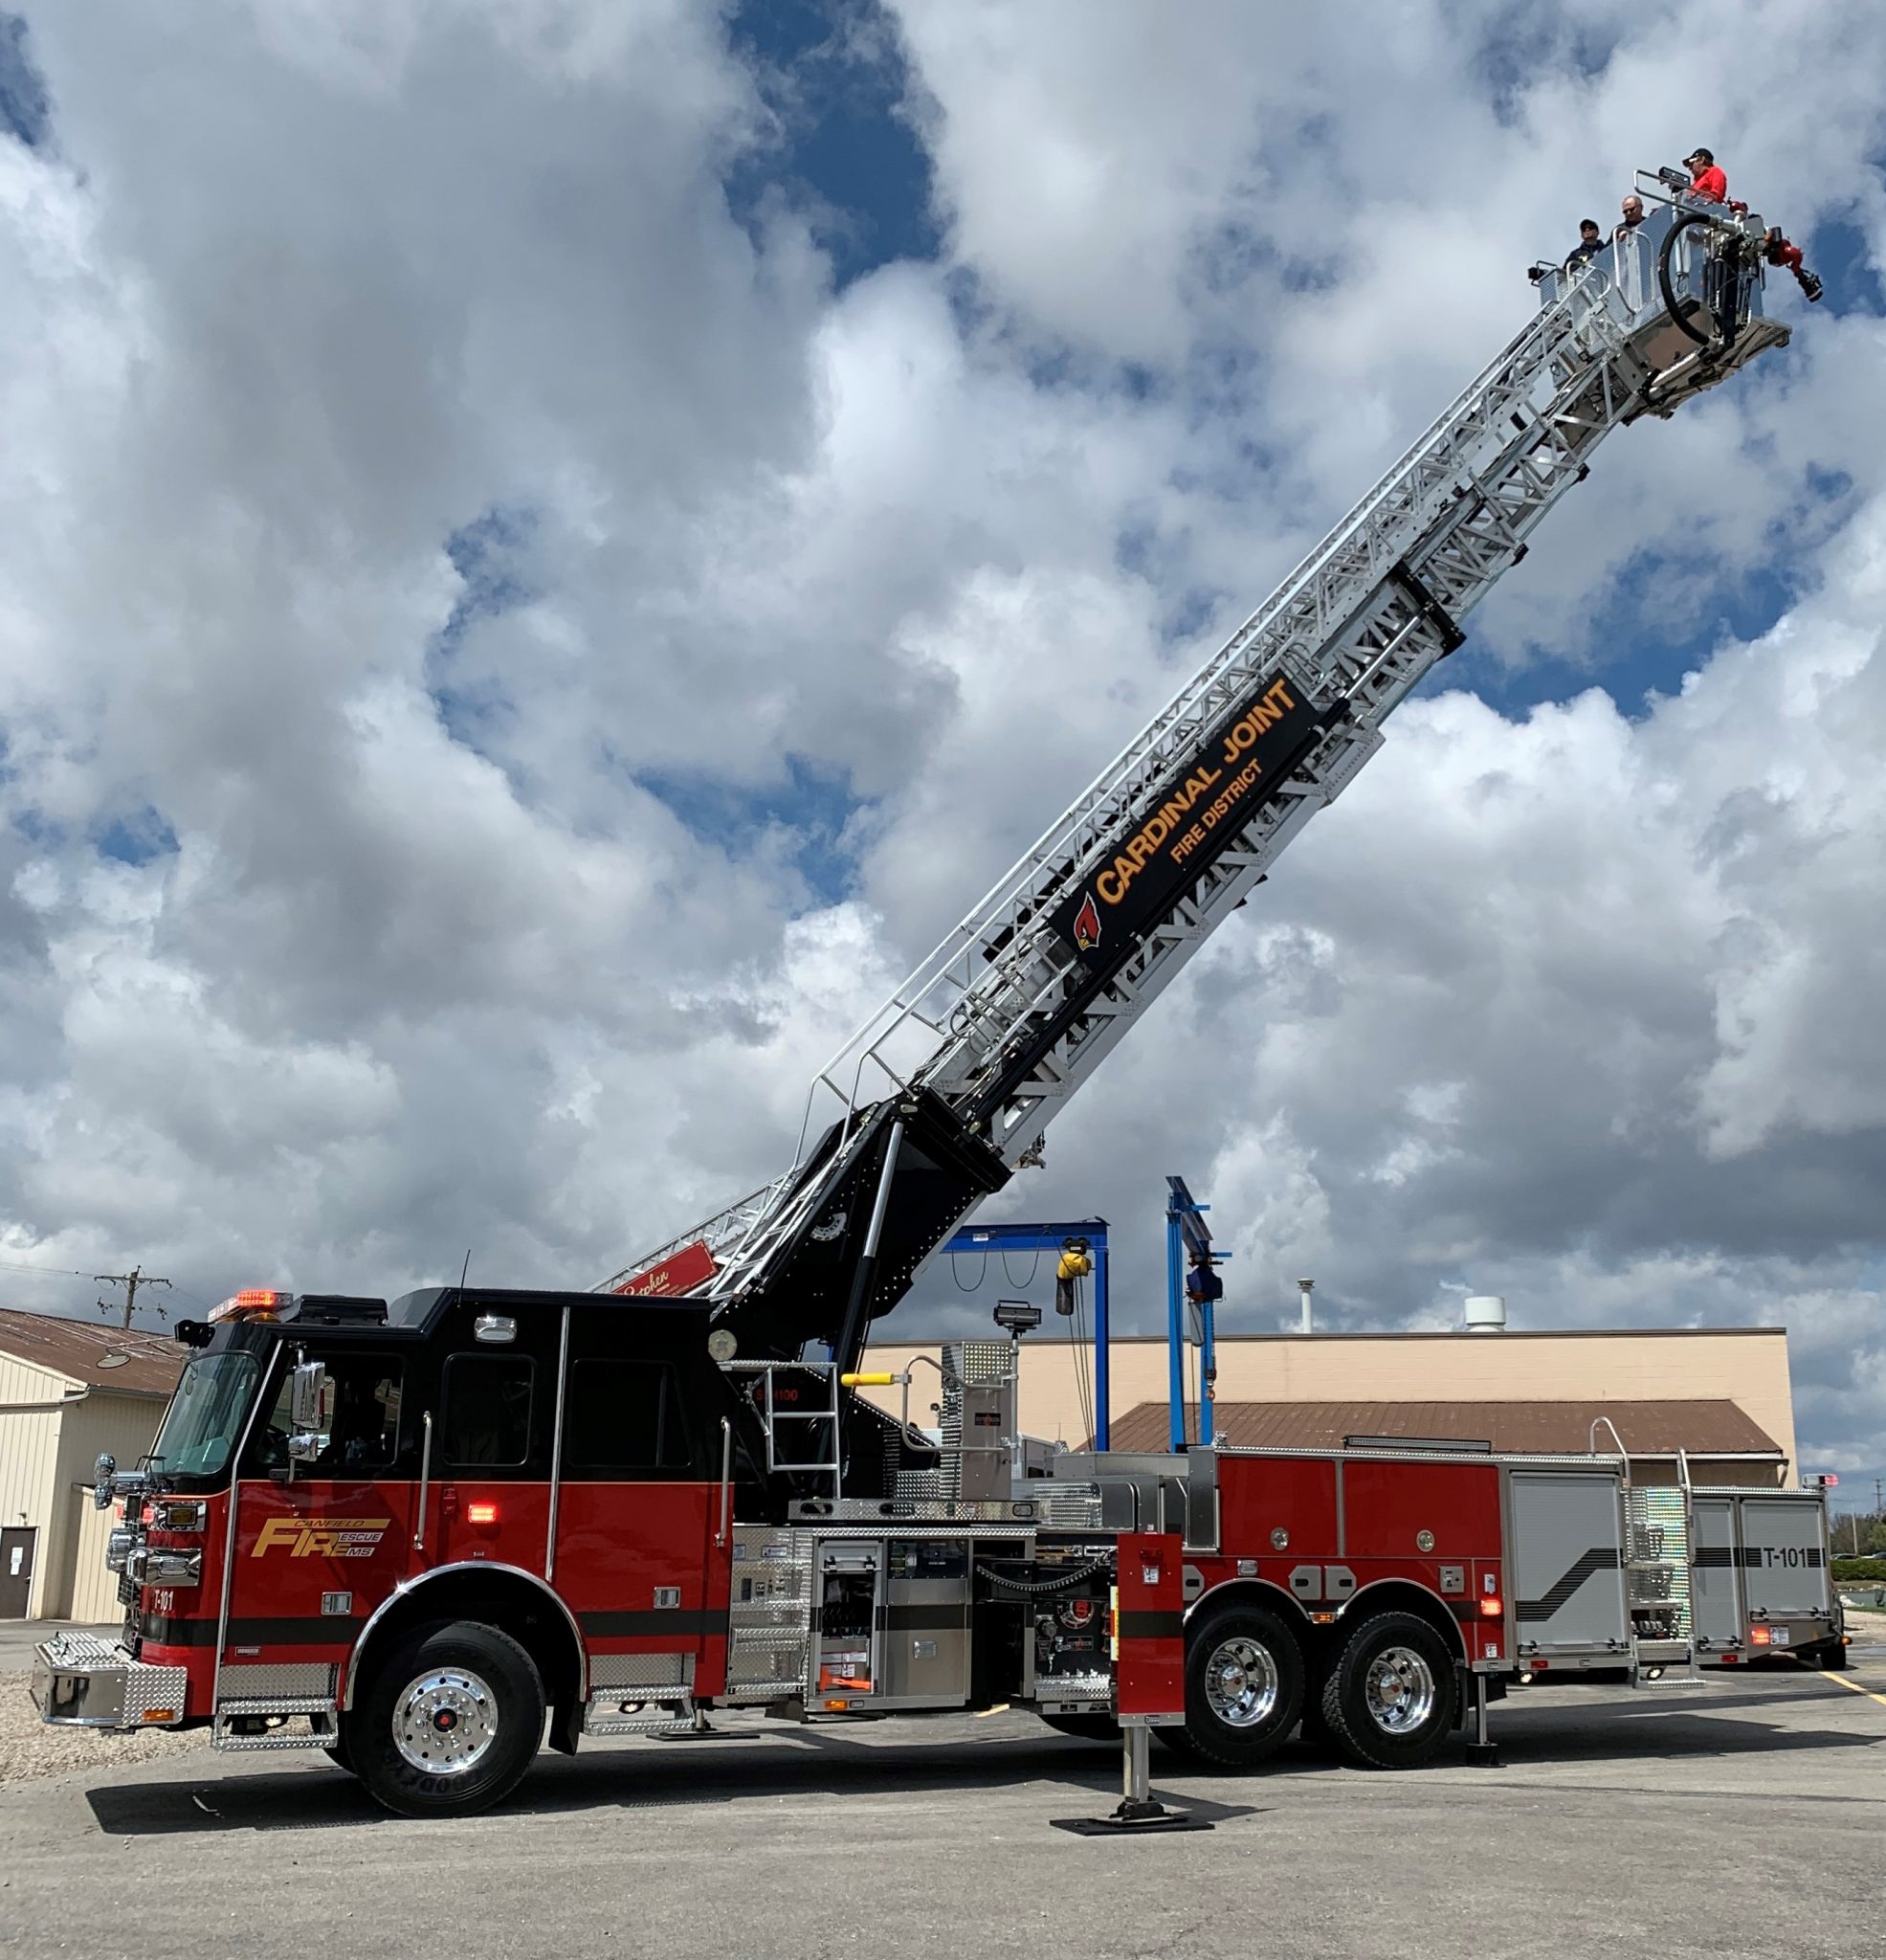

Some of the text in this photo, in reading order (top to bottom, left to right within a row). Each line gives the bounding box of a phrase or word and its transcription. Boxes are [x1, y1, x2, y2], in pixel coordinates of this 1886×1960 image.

[1097, 678, 1296, 904] CARDINAL JOINT
[1169, 758, 1263, 864] FIRE DISTRICT
[1763, 1547, 1807, 1569] T-101
[154, 1589, 174, 1612] T-101
